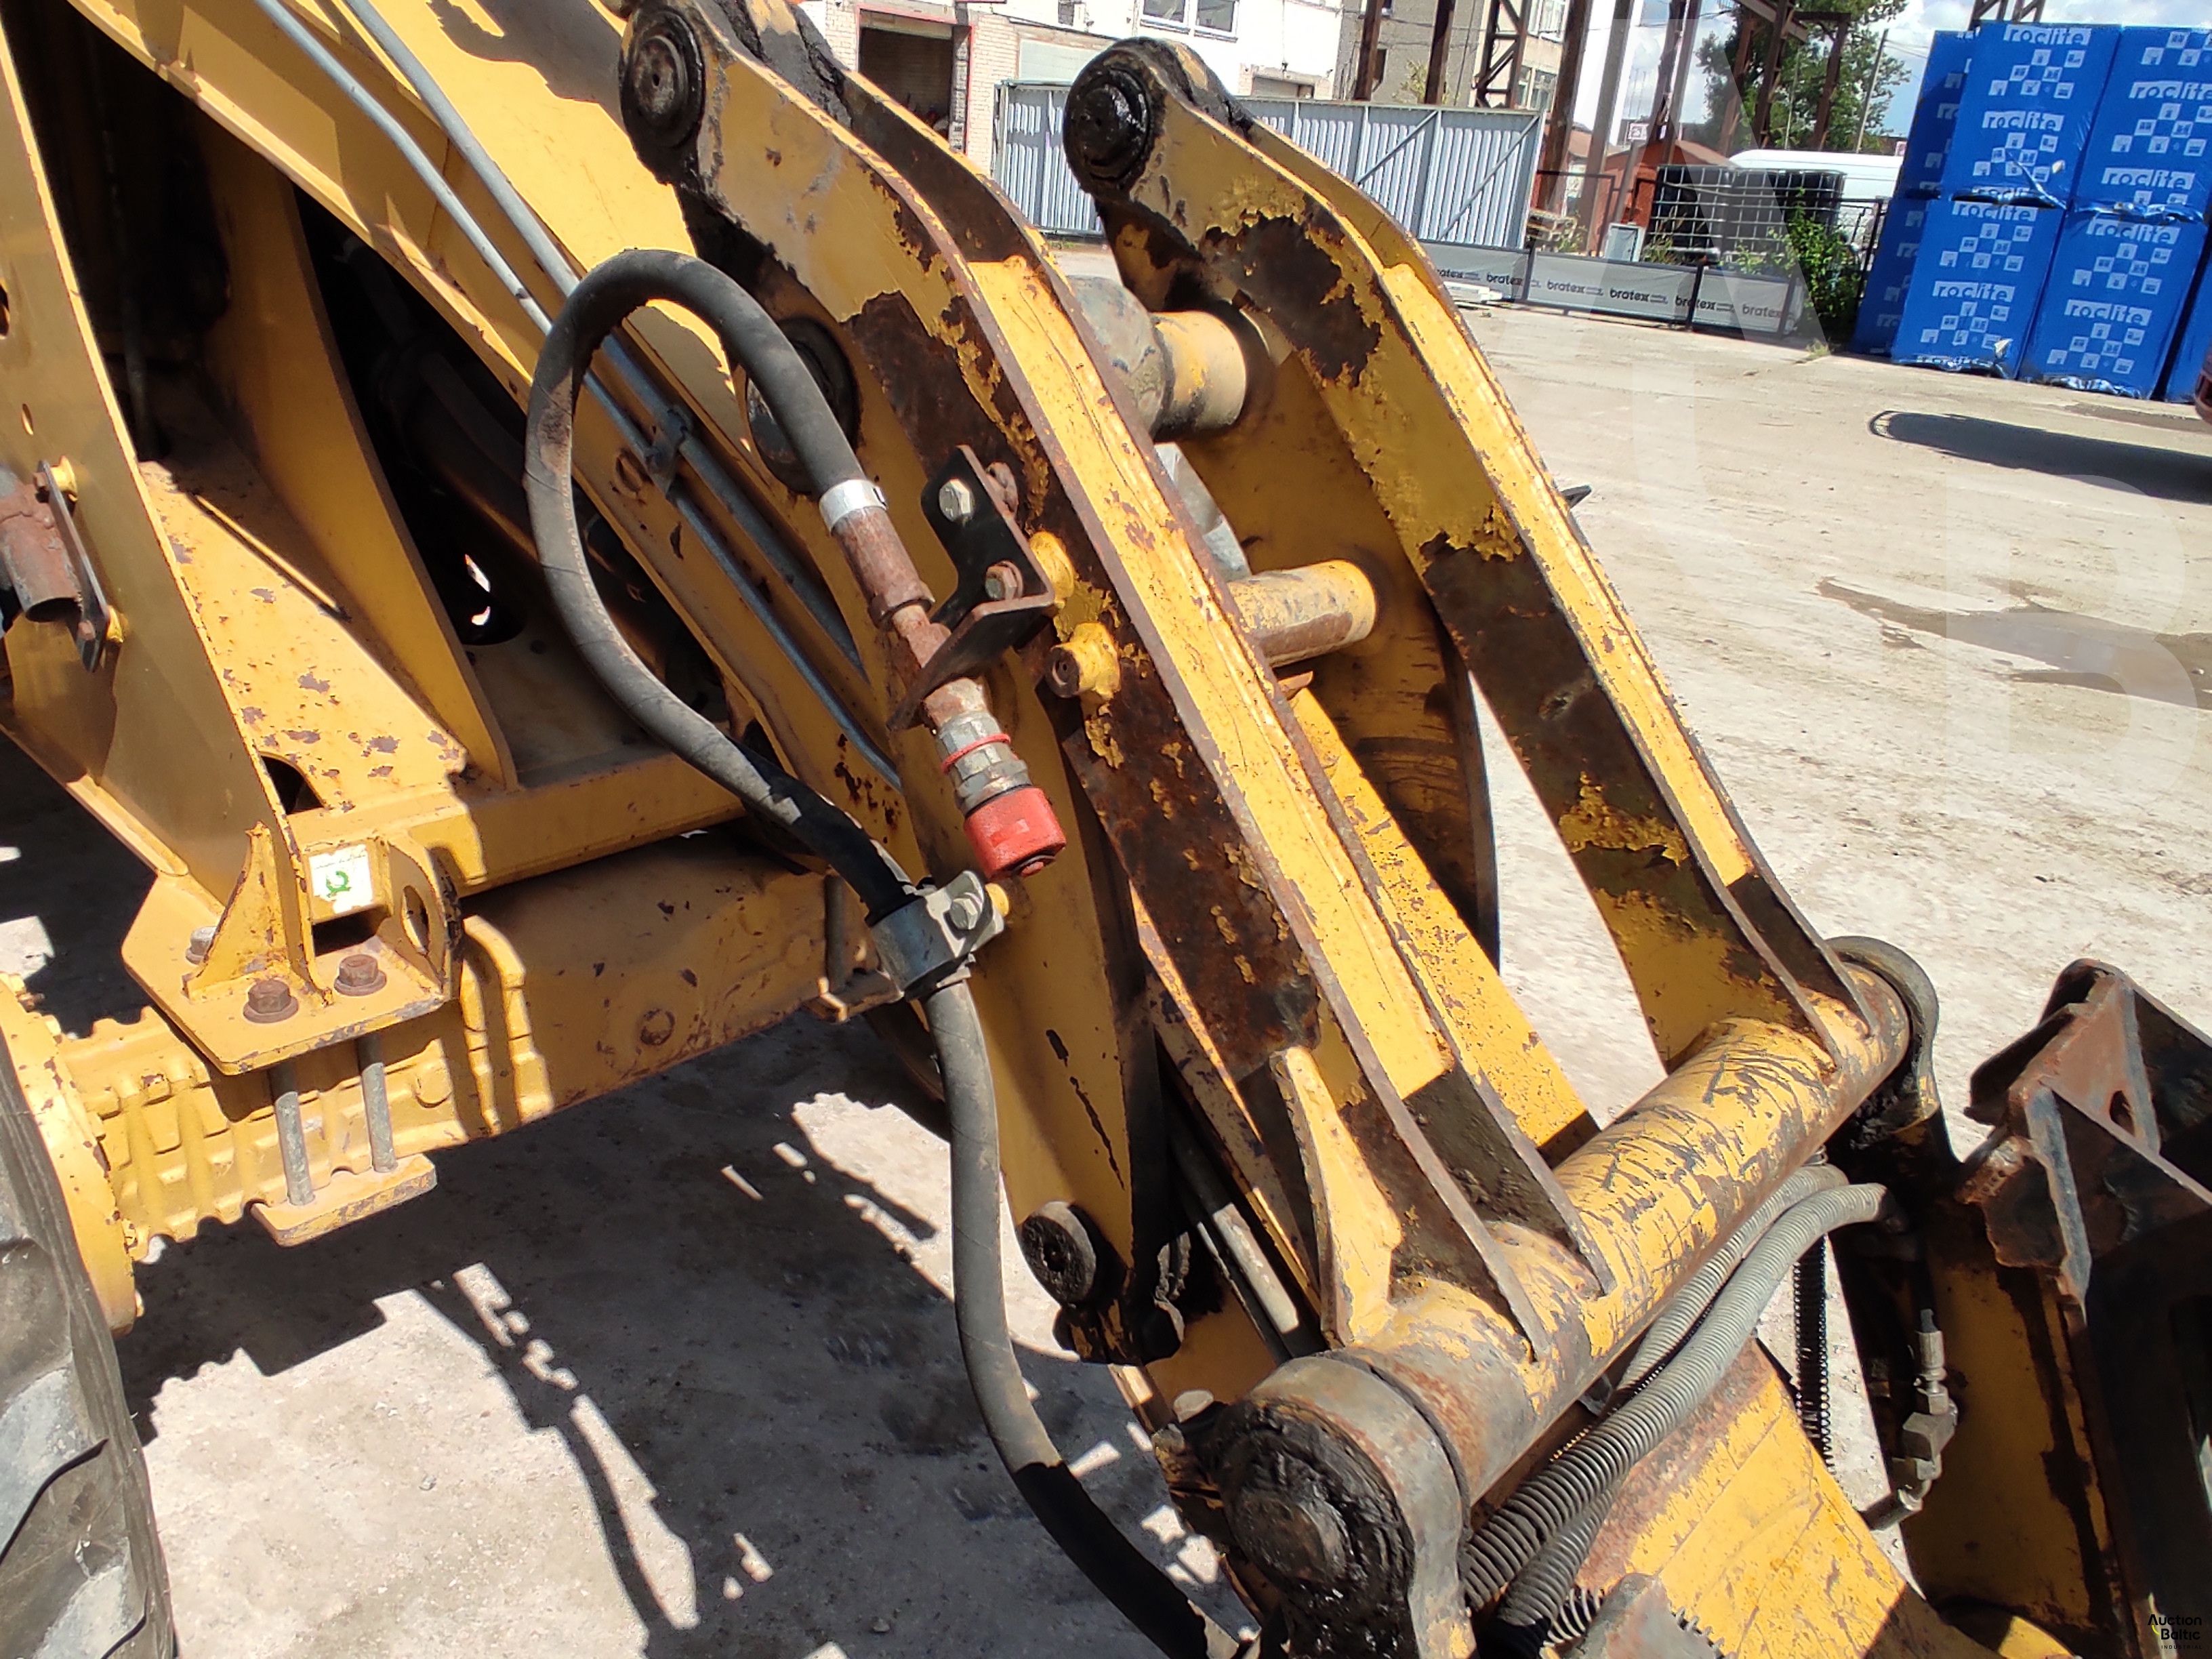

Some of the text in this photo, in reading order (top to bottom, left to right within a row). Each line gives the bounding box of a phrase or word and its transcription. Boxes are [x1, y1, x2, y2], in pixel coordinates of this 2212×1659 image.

[2006, 26, 2088, 45] roclite
[1985, 112, 2061, 131] roclite
[2105, 169, 2190, 189] roclite
[1955, 201, 2034, 222] roclite
[2091, 220, 2176, 243] roclite
[1936, 281, 2011, 302] roclite
[2068, 301, 2148, 325] roclite
